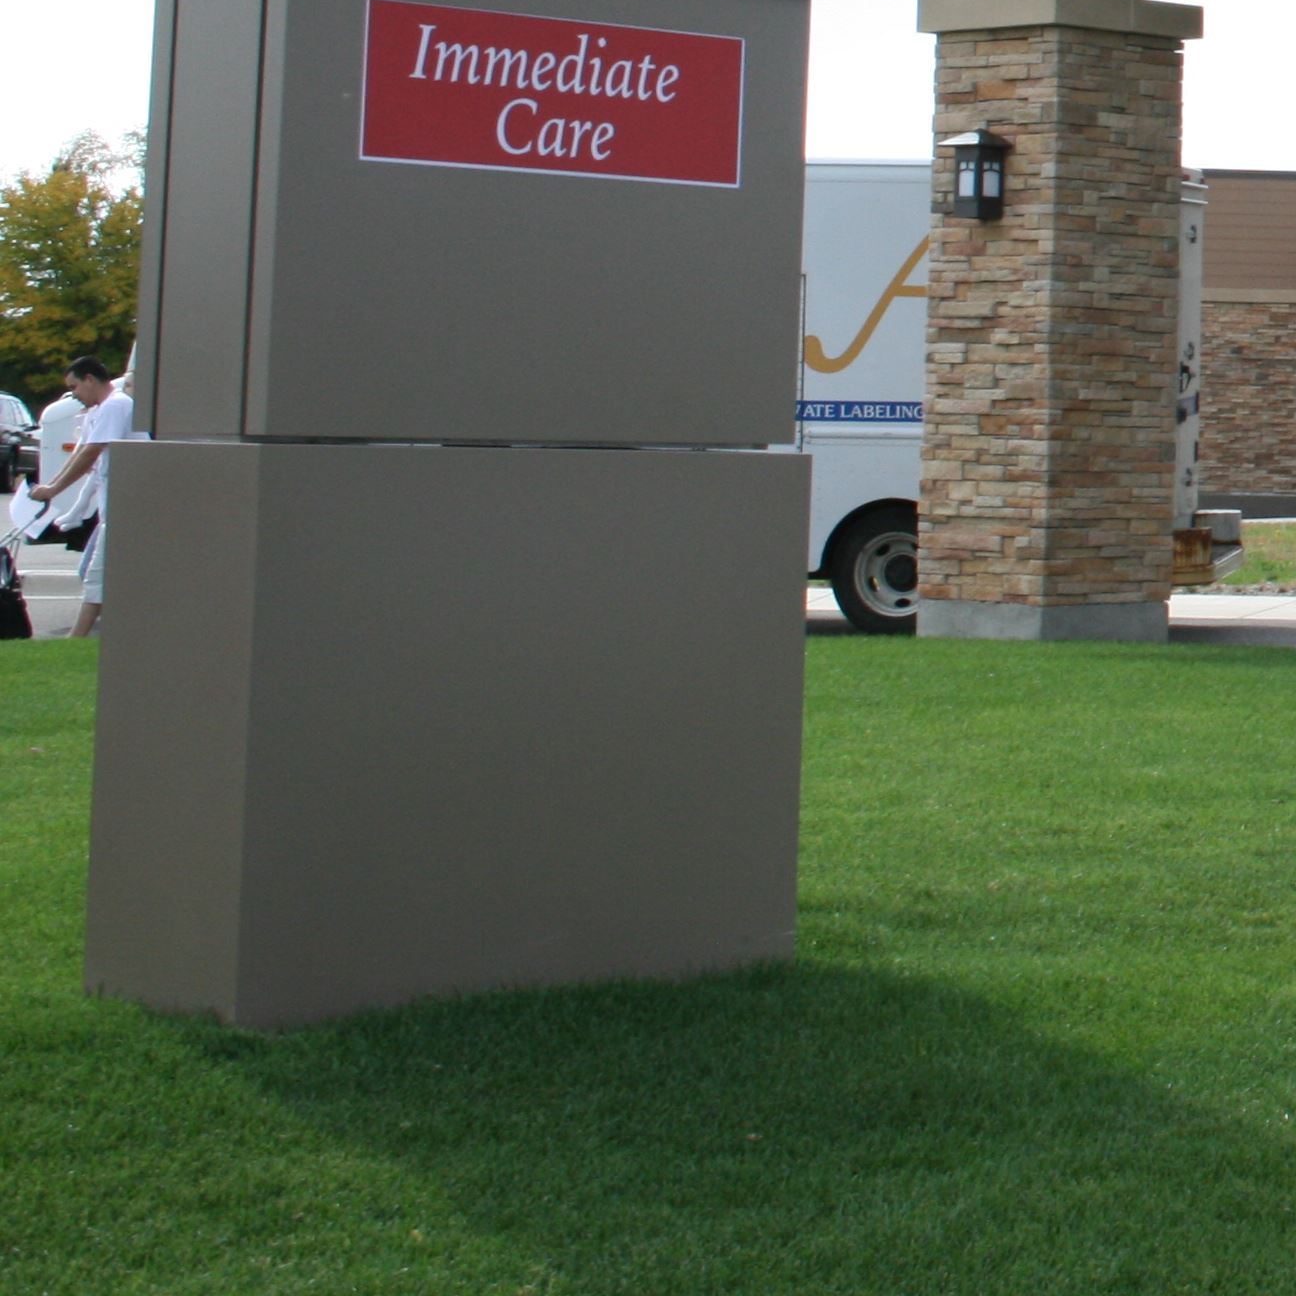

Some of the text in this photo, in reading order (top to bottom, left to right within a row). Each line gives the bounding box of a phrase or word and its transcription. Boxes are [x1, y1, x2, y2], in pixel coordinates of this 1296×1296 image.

[408, 23, 680, 103] Immediate
[496, 97, 615, 161] Care
[840, 404, 925, 420] LABELING
